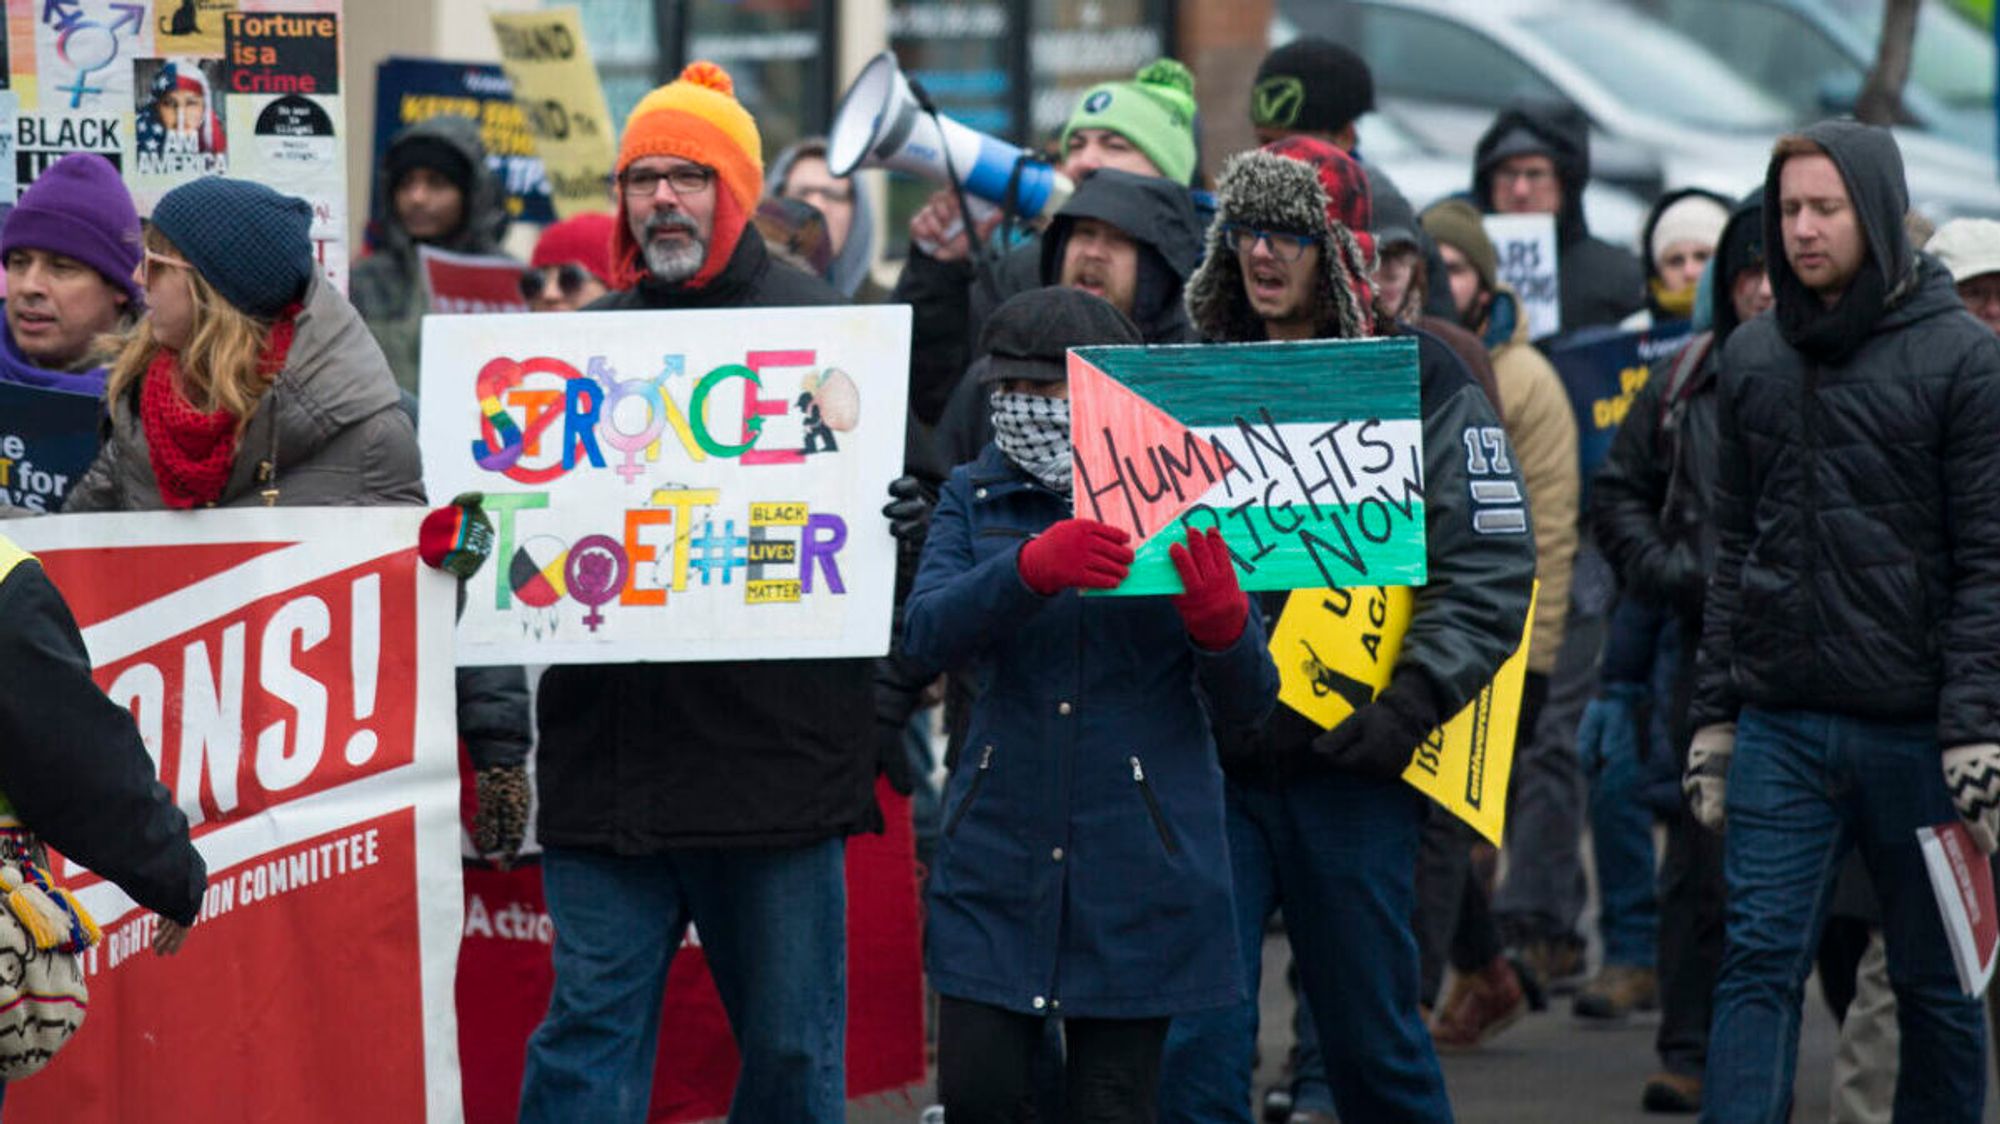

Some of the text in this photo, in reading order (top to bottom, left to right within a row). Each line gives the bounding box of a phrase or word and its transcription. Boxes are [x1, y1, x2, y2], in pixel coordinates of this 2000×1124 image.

[227, 13, 335, 37] Torture
[233, 41, 278, 65] is a
[231, 68, 316, 93] Crime
[17, 116, 121, 148] BLACK
[166, 130, 199, 152] AM
[138, 152, 228, 174] AMERICA
[1464, 427, 1512, 474] 17
[18, 461, 68, 497] for
[1071, 406, 1295, 538] HUMAN
[1180, 417, 1395, 575] RIGHTS
[753, 506, 805, 521] BLACK
[1299, 444, 1426, 588] NOW
[748, 543, 795, 561] LIVES
[746, 582, 802, 599] MATTER
[239, 829, 378, 905] COMMITTEE
[465, 892, 556, 945] Actio
